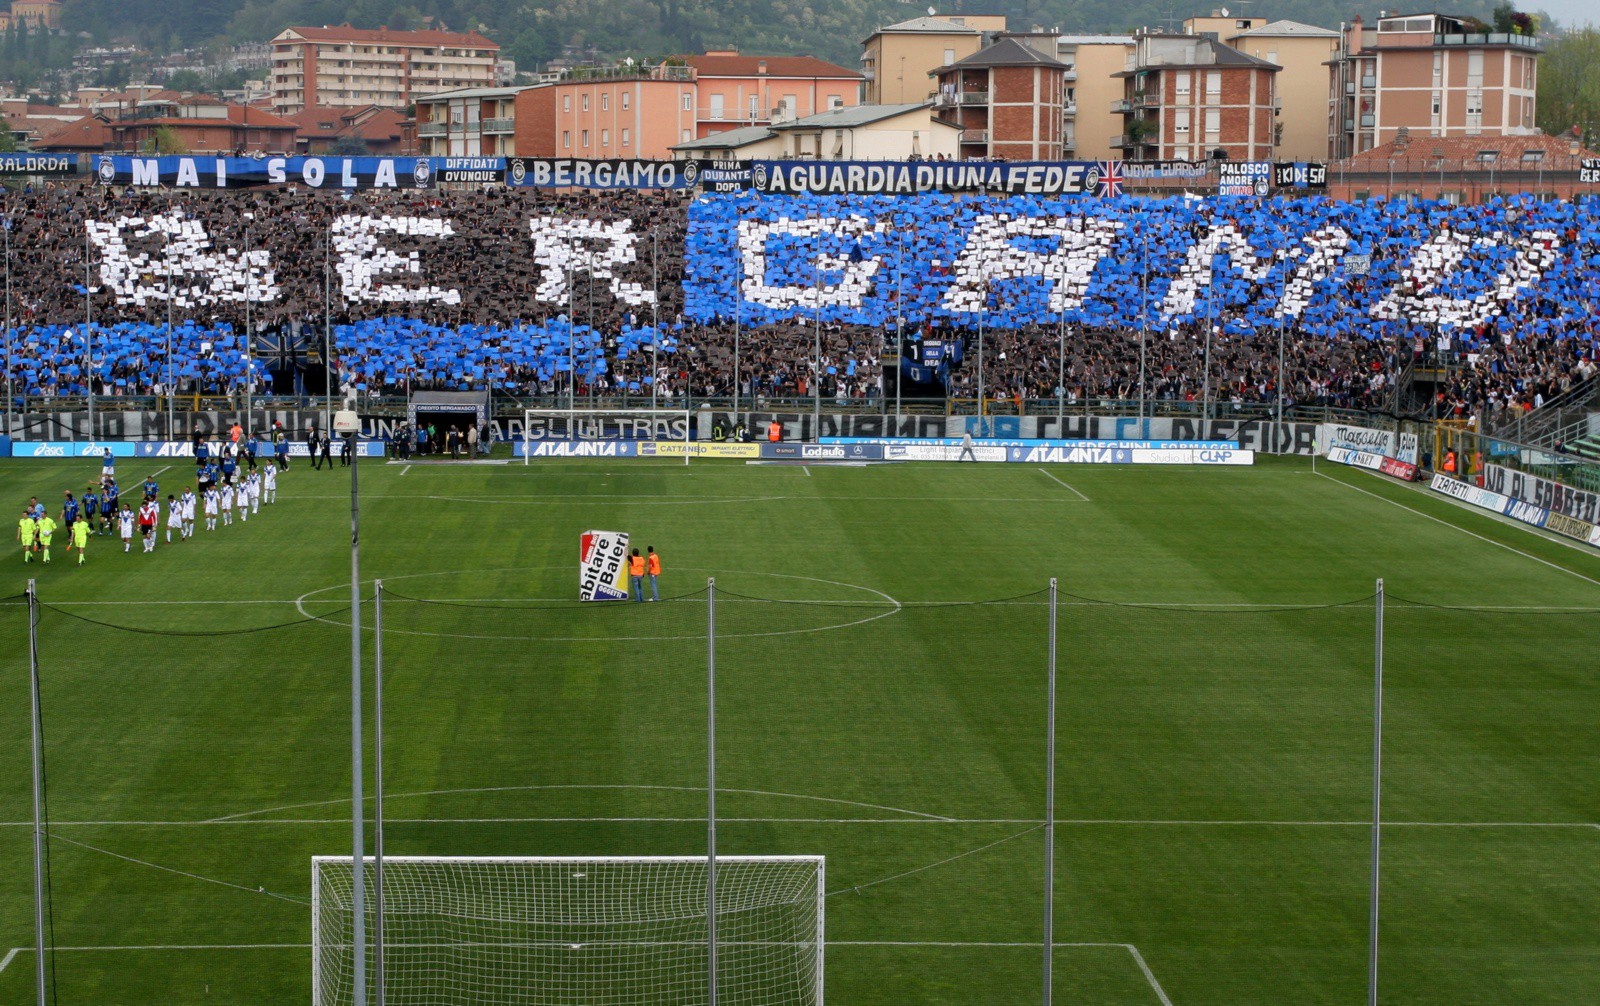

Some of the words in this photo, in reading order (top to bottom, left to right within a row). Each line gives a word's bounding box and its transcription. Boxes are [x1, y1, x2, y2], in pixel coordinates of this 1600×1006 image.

[446, 158, 498, 169] DIFFIDATI
[713, 161, 741, 169] PRIMA
[1220, 163, 1269, 174] PALOSCO
[132, 158, 226, 187] MAI
[268, 158, 398, 187] SOLA
[533, 160, 676, 187] BERGAMO
[704, 170, 751, 180] DURANTE
[1121, 164, 1154, 177] NUOVA
[1160, 162, 1206, 177] GUARDIA
[445, 171, 496, 182] OVUNQUE
[1220, 175, 1253, 185] AMORE
[716, 182, 741, 191] DOPO
[924, 359, 939, 367] DEA
[577, 418, 687, 440] ULTRAS
[533, 441, 616, 456] ATALANTA
[660, 445, 707, 453] CATTANEO
[802, 446, 845, 456] Lodauto
[1025, 447, 1113, 463] ATALANTA
[1150, 452, 1179, 462] Studio
[1437, 476, 1470, 499] ZANETTI
[599, 533, 629, 585] Baleri
[581, 538, 609, 600] abitare
